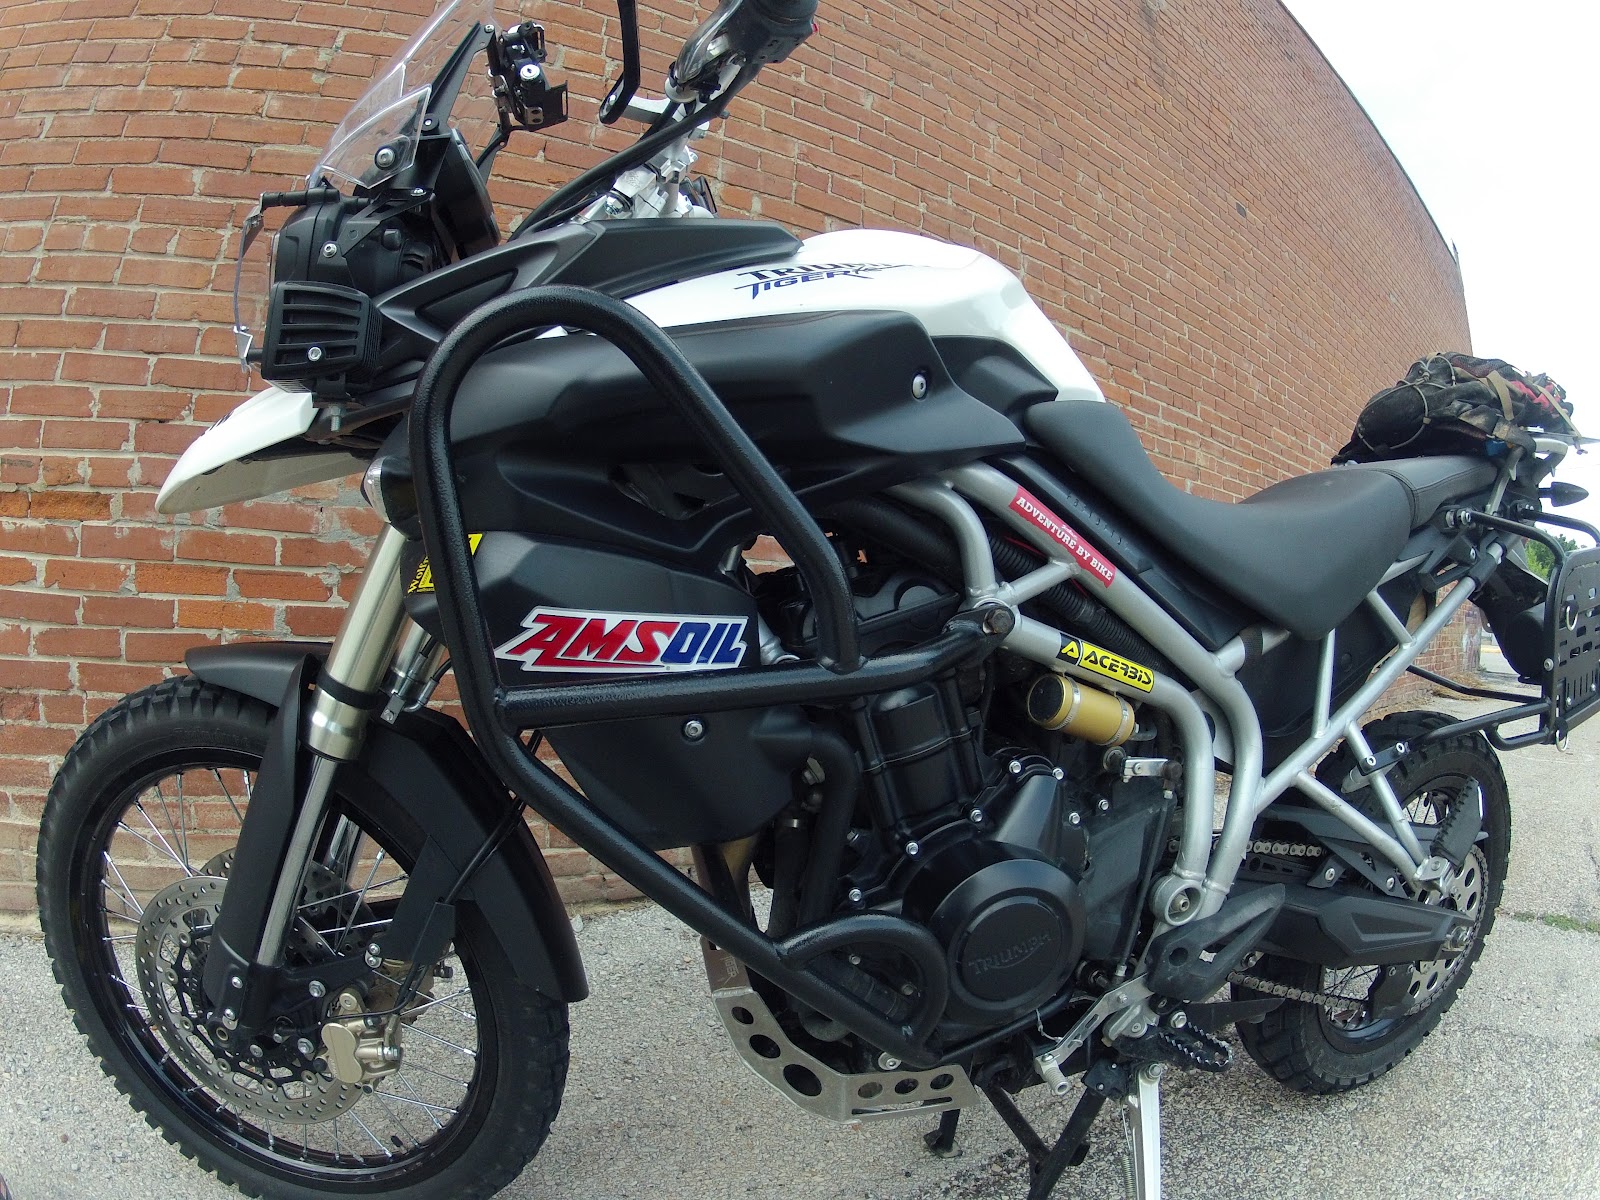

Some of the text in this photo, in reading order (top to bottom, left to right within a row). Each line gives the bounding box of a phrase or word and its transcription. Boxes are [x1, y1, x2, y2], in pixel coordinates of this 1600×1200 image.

[734, 270, 874, 299] TIGER
[1016, 497, 1077, 550] ADVENTURE
[1076, 546, 1091, 561] BY
[1090, 557, 1113, 581] BIKE
[505, 614, 744, 668] AMSOIL
